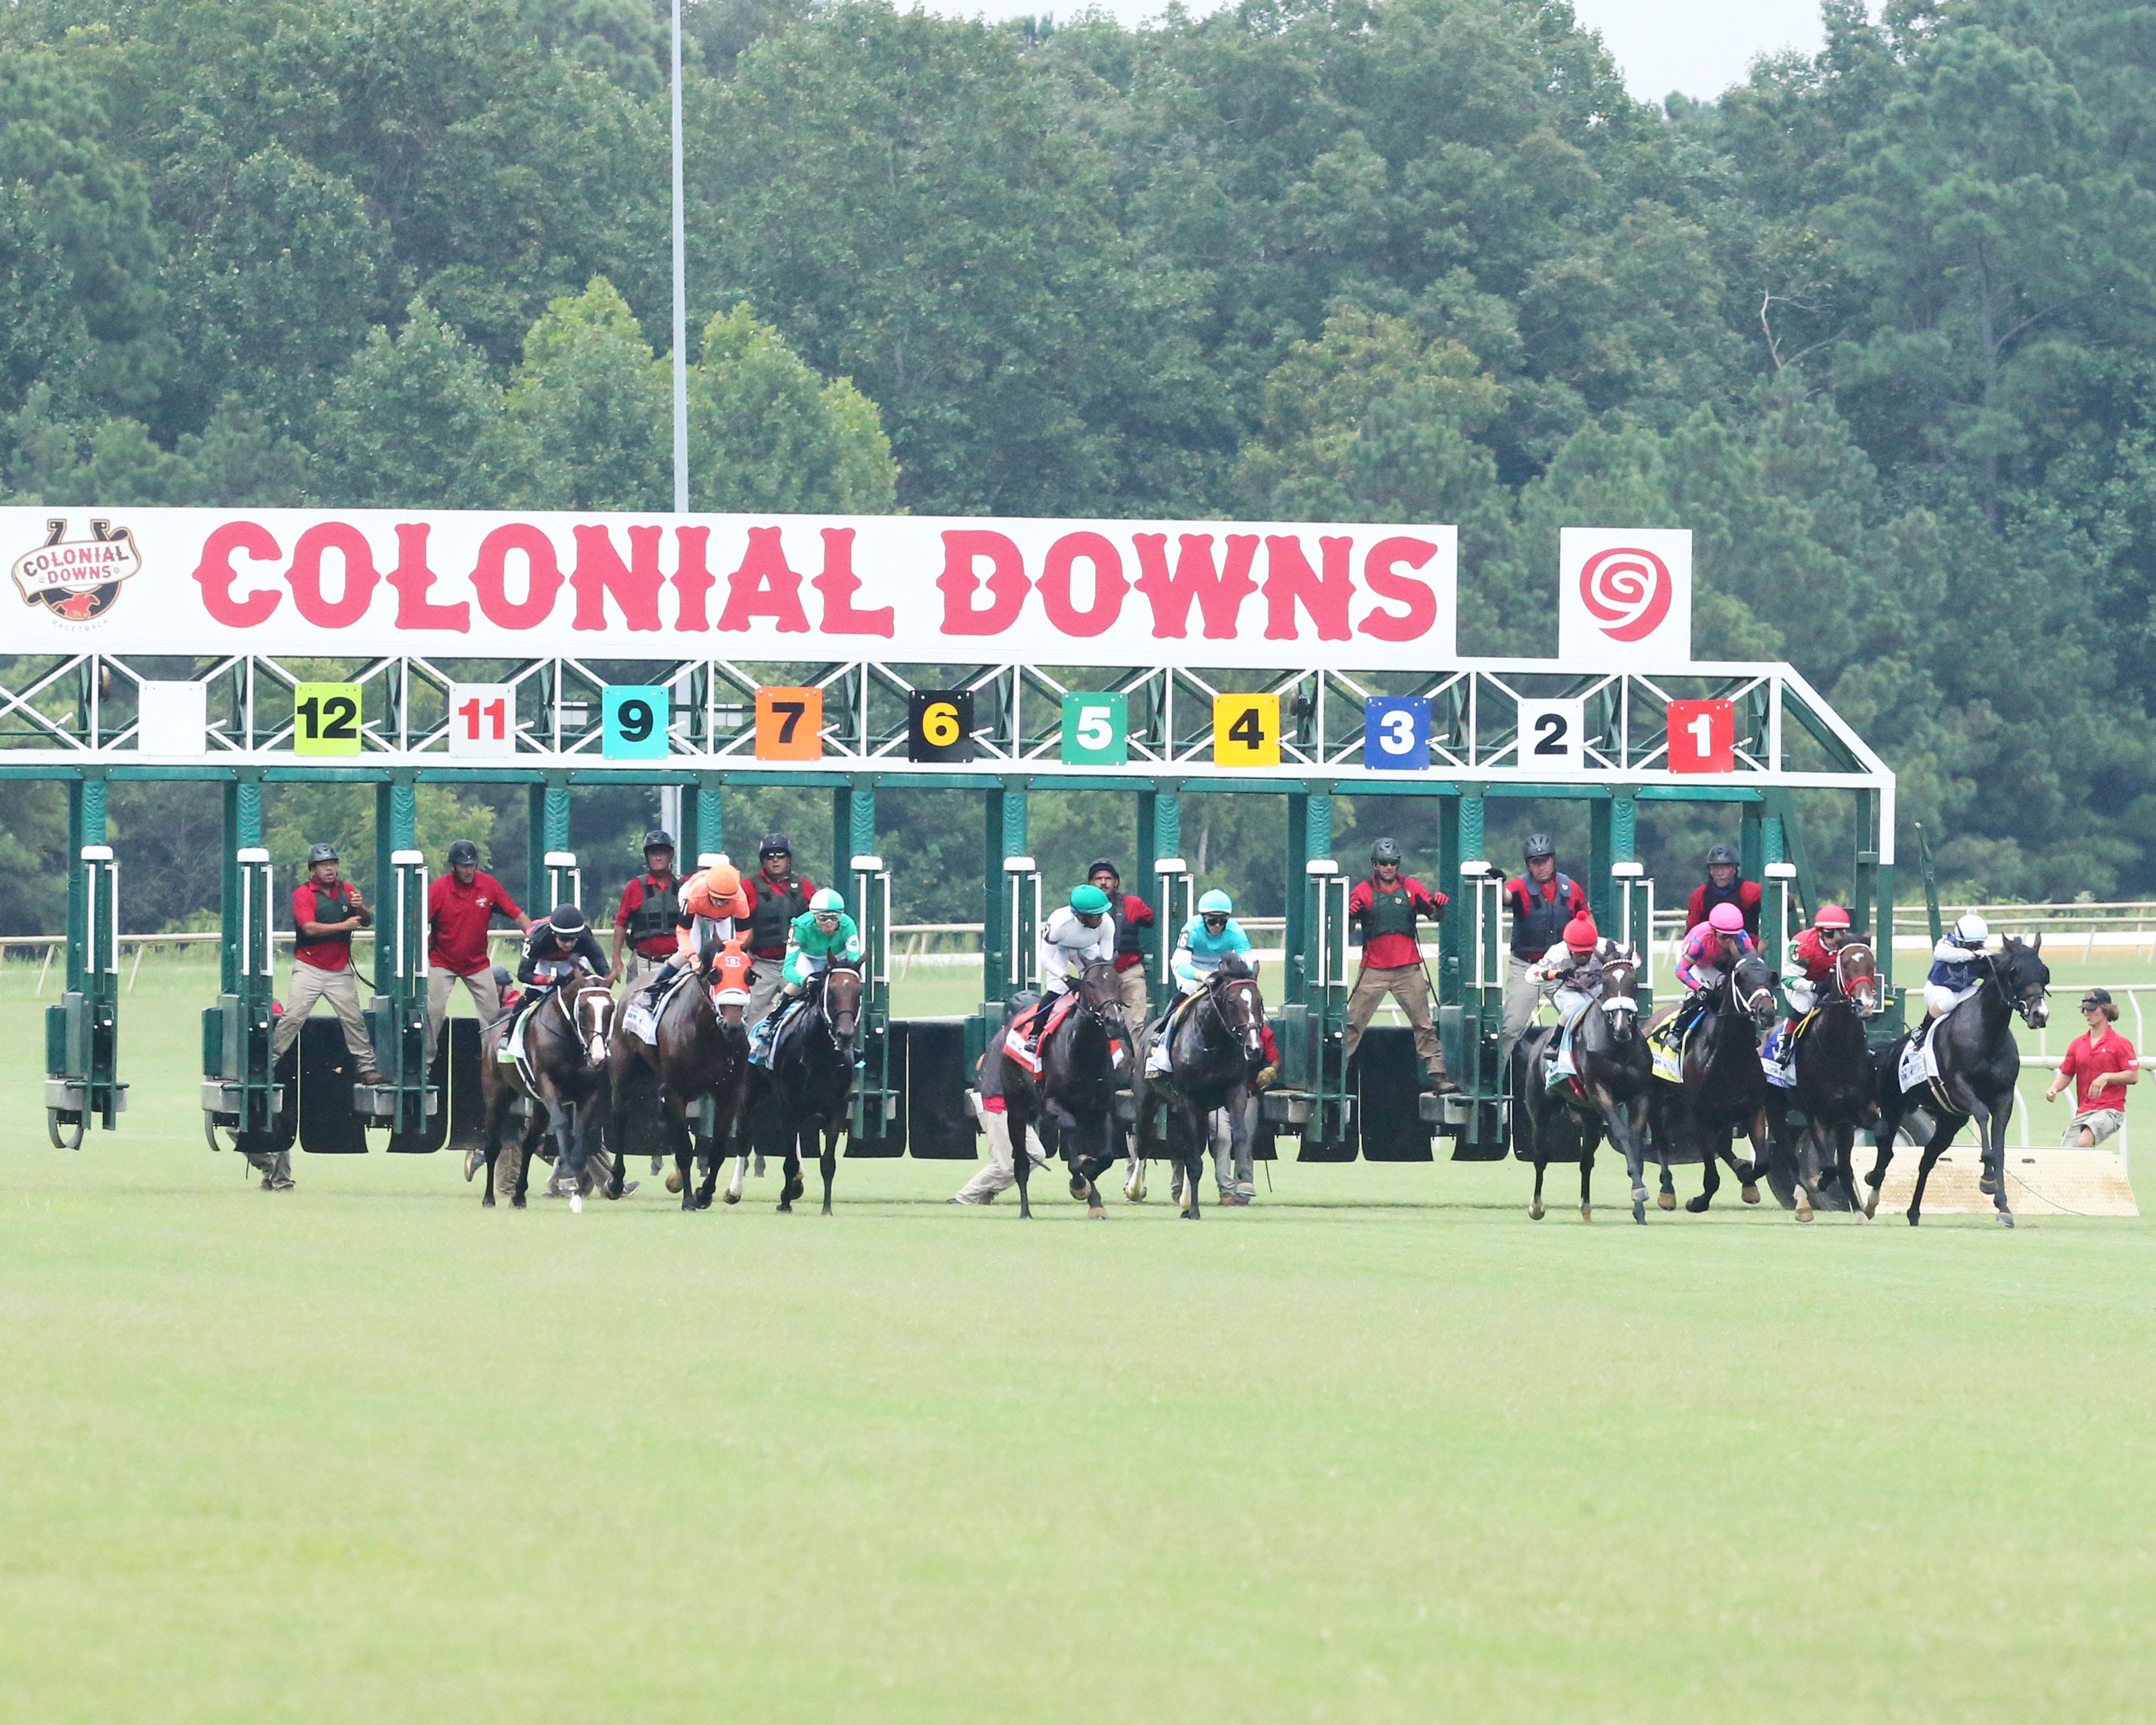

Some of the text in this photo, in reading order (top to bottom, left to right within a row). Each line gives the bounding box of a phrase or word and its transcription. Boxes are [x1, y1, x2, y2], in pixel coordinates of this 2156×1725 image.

[23, 546, 129, 577] COLONIAL
[47, 565, 112, 584] DOWNS
[192, 520, 1438, 642] COLONIAL DOWNS
[297, 697, 357, 739] 12
[459, 698, 505, 740] 11
[618, 699, 653, 742] 9
[771, 702, 805, 743] 7
[922, 702, 961, 747] 6
[1076, 706, 1113, 750] 5
[1229, 709, 1264, 750] 4
[1379, 710, 1415, 755] 3
[1534, 713, 1567, 755] 2
[1687, 713, 1711, 757] 1
